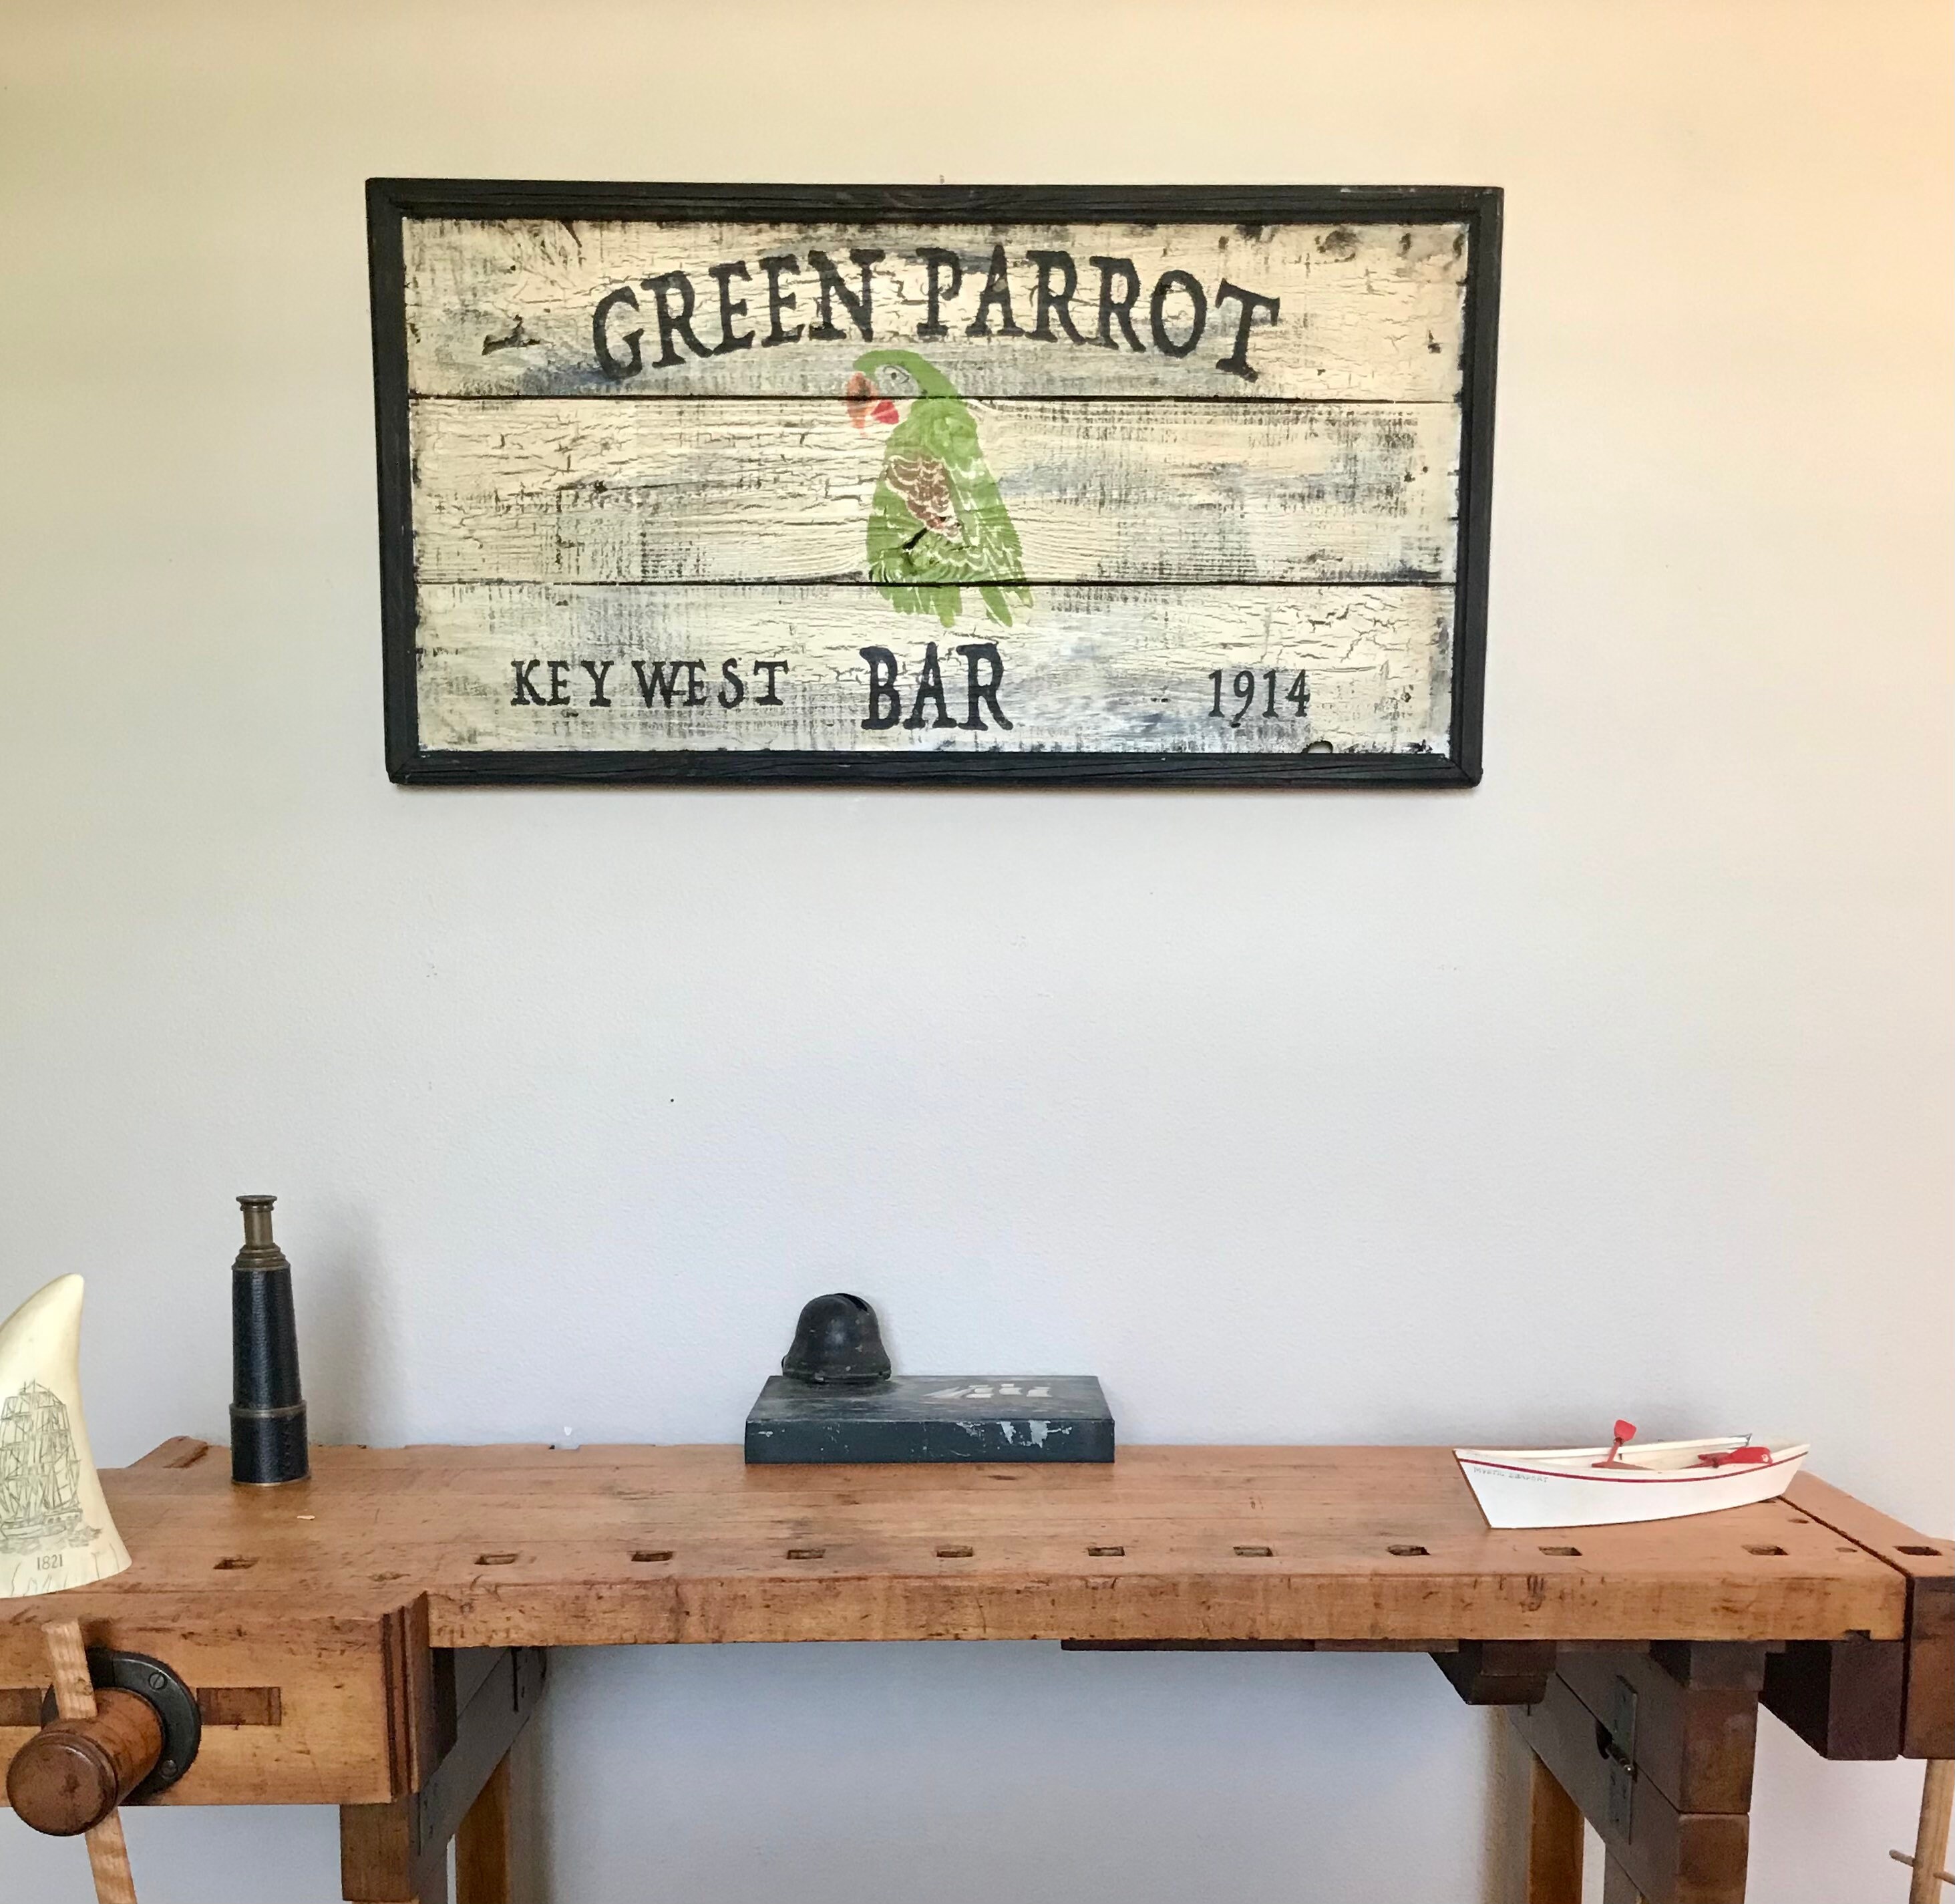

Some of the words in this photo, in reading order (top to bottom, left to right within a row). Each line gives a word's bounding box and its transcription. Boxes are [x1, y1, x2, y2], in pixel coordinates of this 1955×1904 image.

[592, 247, 886, 380] GREEN
[916, 245, 1280, 382] PARROT
[510, 659, 614, 707] KEY
[631, 658, 789, 709] WEST
[859, 641, 1013, 730] BAR
[1208, 669, 1310, 728] 1914
[37, 1554, 64, 1571] 1821
